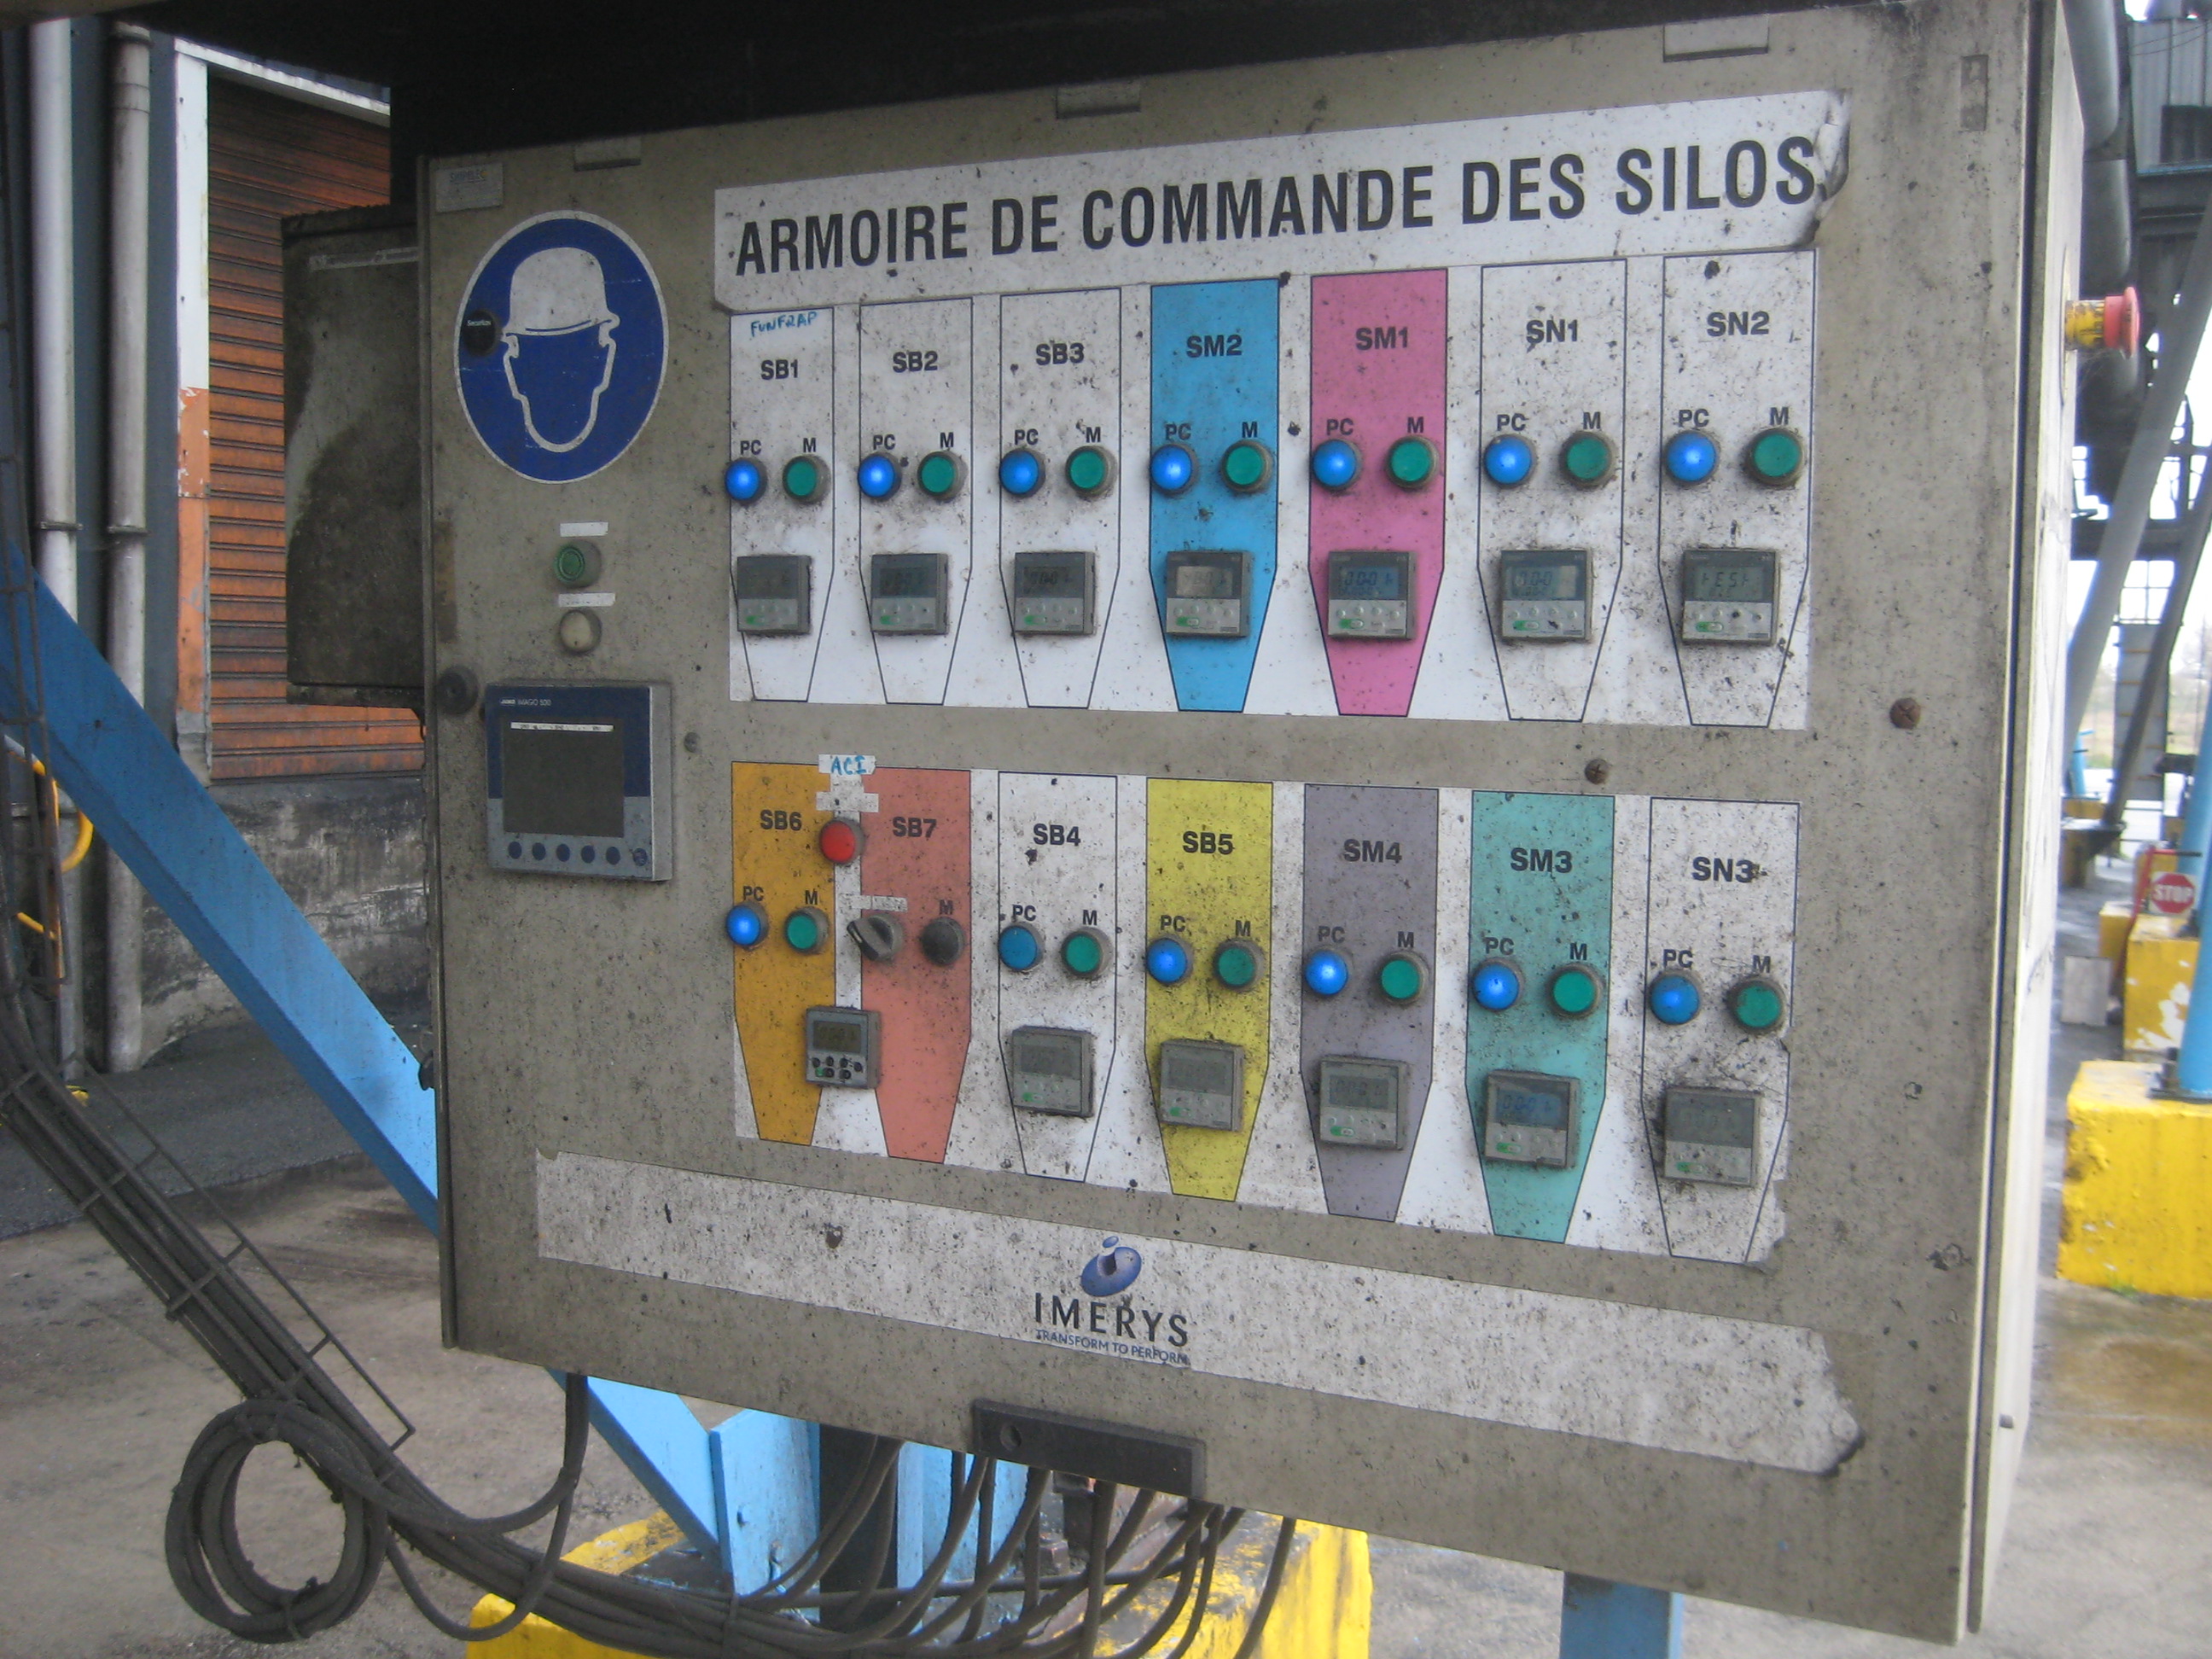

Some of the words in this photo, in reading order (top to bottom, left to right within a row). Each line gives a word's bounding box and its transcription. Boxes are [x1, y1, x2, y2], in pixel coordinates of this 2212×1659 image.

[736, 202, 968, 276] ARMOIRE
[992, 195, 1058, 255] DE
[1082, 165, 1433, 250] COMMANDE
[1463, 154, 1585, 224] DES
[1616, 136, 1815, 215] SILOS
[1527, 319, 1578, 343] SN1
[1708, 311, 1770, 337] SN2
[1186, 335, 1243, 358] SM2
[1356, 327, 1408, 351] SM1
[893, 351, 938, 373] SB2
[1036, 343, 1085, 365] SB3
[761, 359, 799, 380] SB1
[1407, 416, 1424, 433] M
[1497, 414, 1526, 431] PC
[1583, 412, 1601, 429] M
[1679, 409, 1709, 428] PC
[1770, 406, 1789, 426] M
[1015, 428, 1039, 445] PC
[1086, 427, 1102, 443] M
[1165, 423, 1191, 440] PC
[1242, 422, 1258, 438] M
[1326, 418, 1353, 436] PC
[741, 439, 761, 455] PC
[803, 438, 817, 452] M
[873, 434, 895, 450] PC
[940, 432, 954, 448] M
[830, 756, 867, 776] ACI
[760, 810, 802, 830] SB6
[893, 817, 937, 838] SB7
[1033, 824, 1080, 846] SB4
[1183, 830, 1234, 855] SB5
[1343, 839, 1402, 864] SM4
[1511, 847, 1573, 873] SM3
[1692, 857, 1755, 882] SN3
[742, 886, 764, 902] PC
[805, 890, 818, 905] M
[2153, 884, 2192, 903] STOP
[940, 899, 954, 915] M
[1012, 905, 1036, 922] PC
[1083, 910, 1097, 926] M
[1161, 915, 1185, 932] PC
[1236, 920, 1251, 937] M
[1318, 925, 1345, 944] PC
[1397, 931, 1414, 948] M
[1485, 937, 1514, 955] PC
[1570, 942, 1587, 961] M
[1664, 949, 1693, 968] PC
[1753, 955, 1771, 973] M
[1035, 1292, 1187, 1347] IMERYS
[1036, 1329, 1109, 1350] TRANSFORM
[1112, 1342, 1128, 1354] TO
[1132, 1345, 1188, 1365] PERFORM
